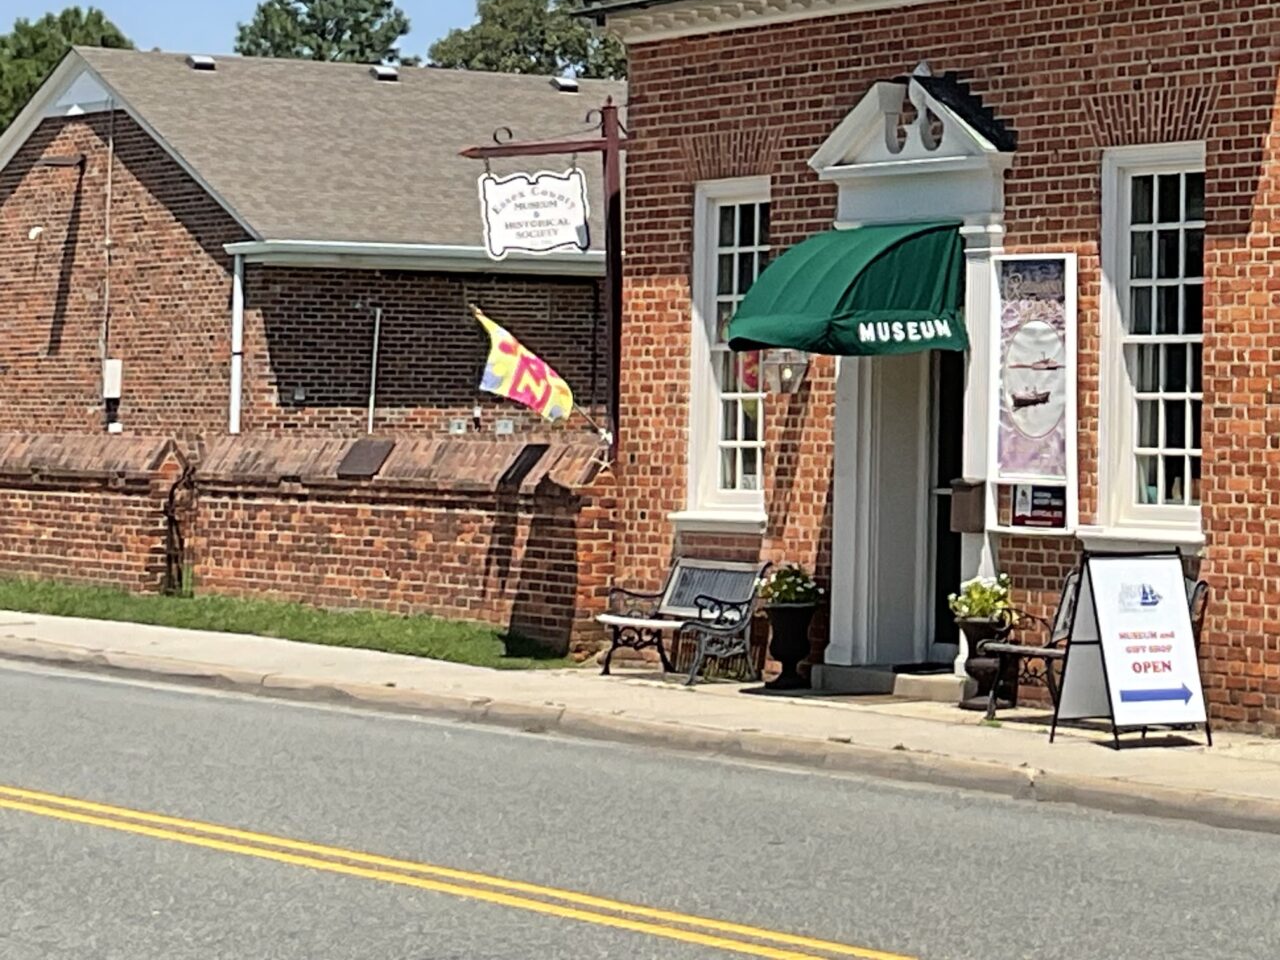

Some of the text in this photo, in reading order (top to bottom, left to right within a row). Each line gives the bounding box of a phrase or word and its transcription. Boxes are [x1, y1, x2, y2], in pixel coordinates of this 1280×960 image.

[514, 200, 558, 211] MUSEUM
[504, 218, 571, 230] HISTORICAL
[515, 228, 559, 239] SOCIETY
[858, 319, 952, 342] MUSEUM
[1119, 631, 1157, 639] MUSEUM
[1126, 645, 1172, 653] GIFT SHOP
[1132, 660, 1172, 674] OPEN
